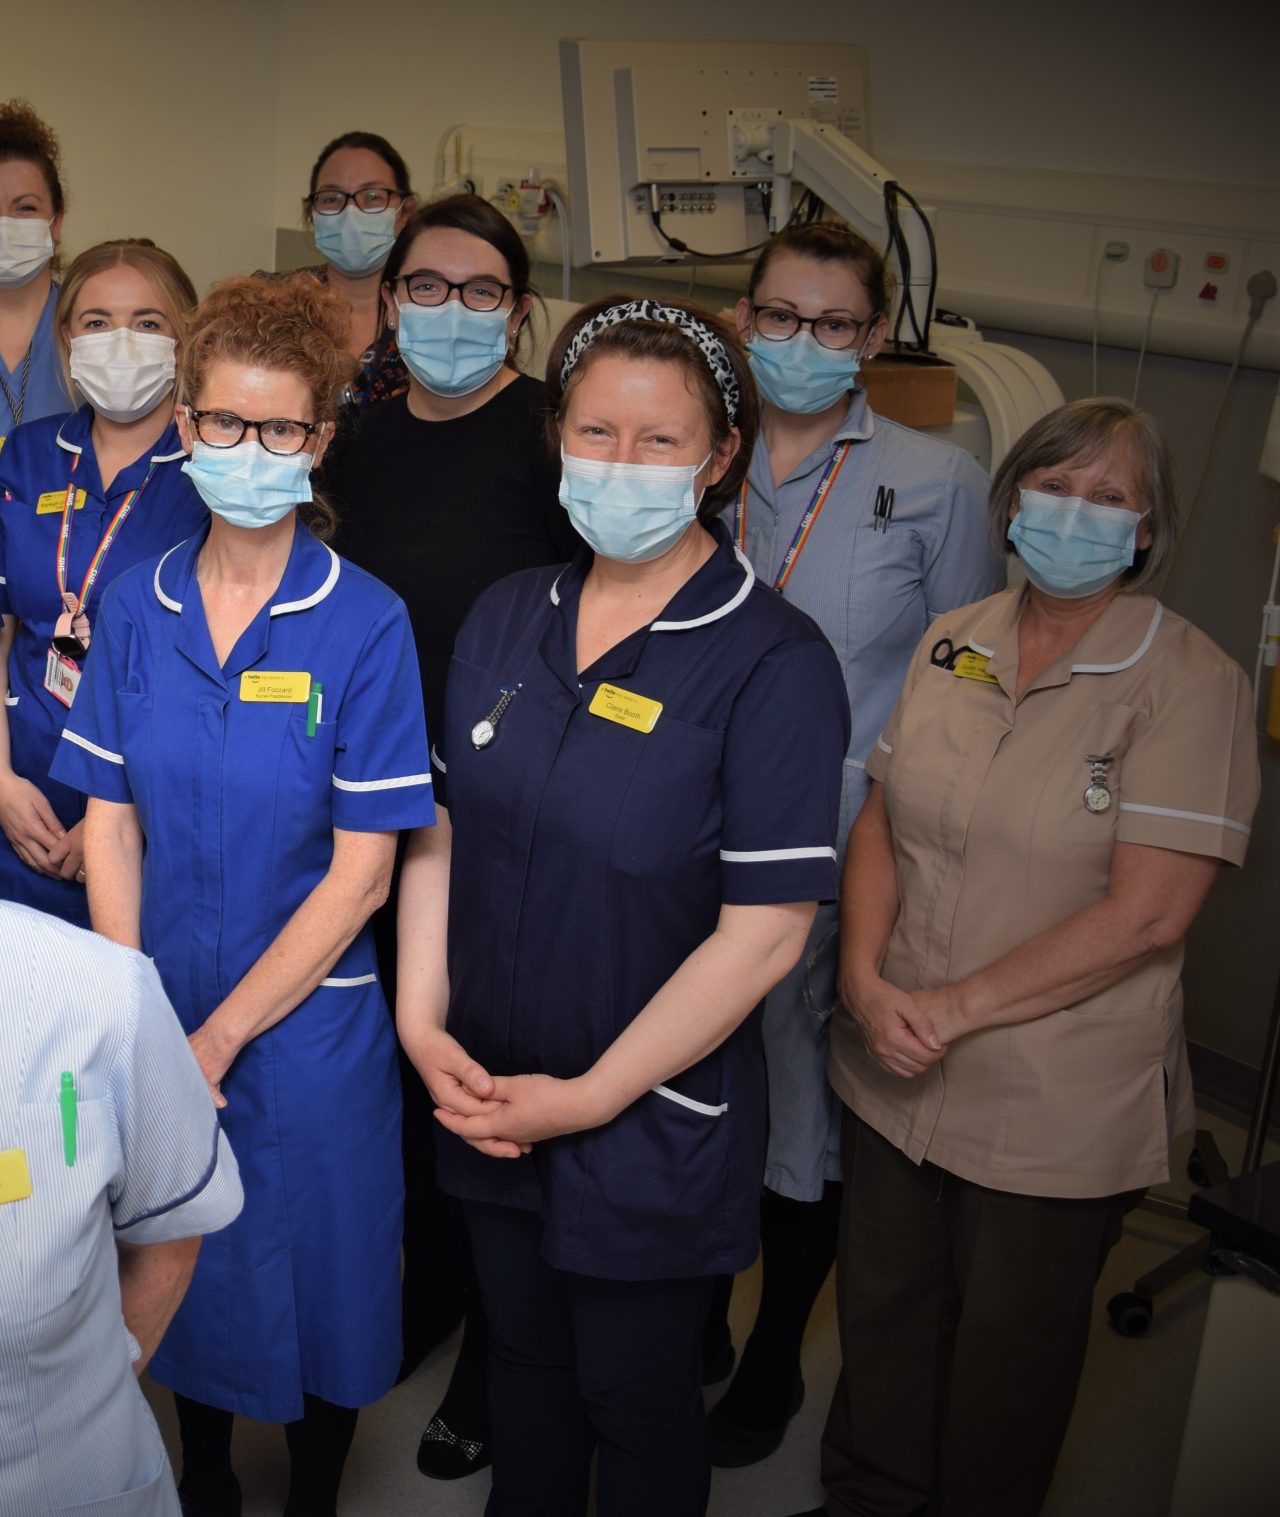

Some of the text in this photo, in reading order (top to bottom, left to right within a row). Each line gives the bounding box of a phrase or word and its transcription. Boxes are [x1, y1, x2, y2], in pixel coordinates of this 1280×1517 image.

[817, 479, 830, 495] NHS
[119, 504, 131, 519] NHS
[801, 512, 814, 528] NHS
[101, 536, 113, 551] NHS
[785, 547, 798, 564] NHS
[88, 569, 98, 585] NHS
[606, 702, 641, 719] Claire Booth
